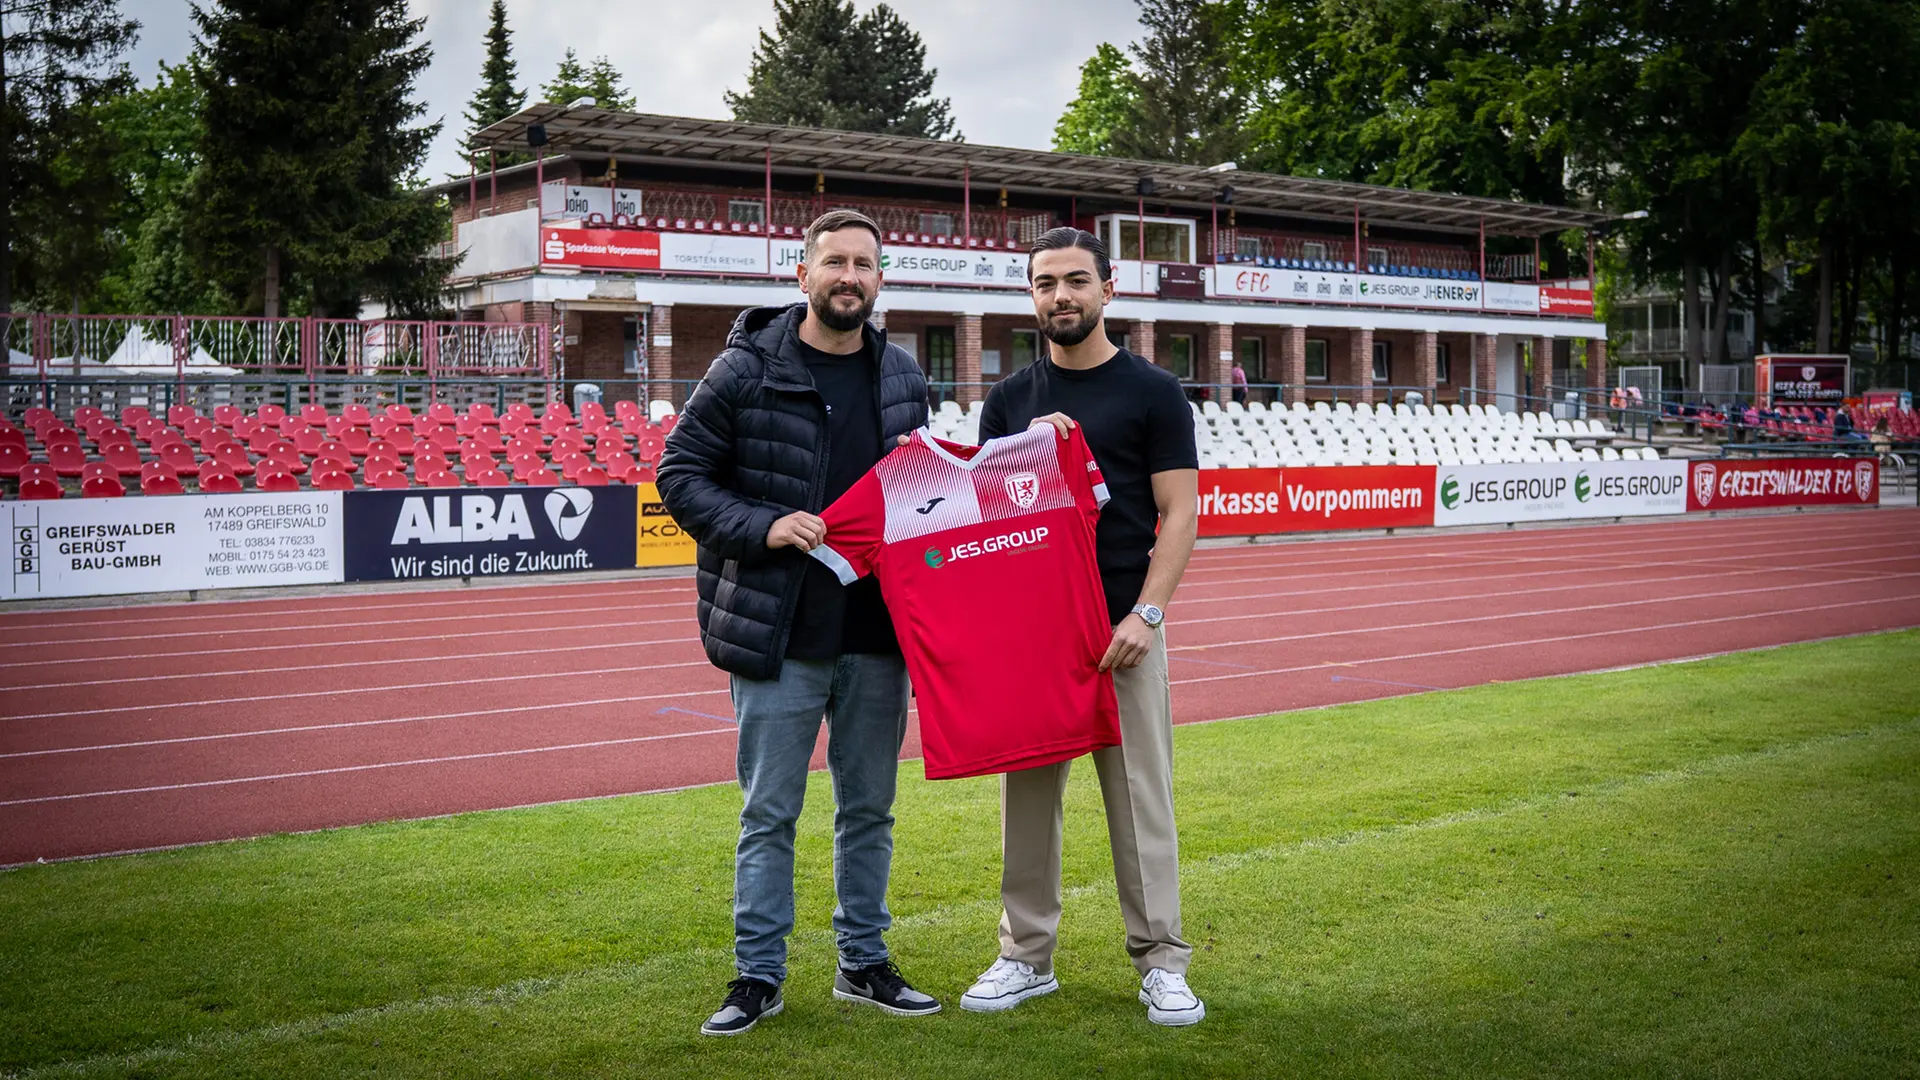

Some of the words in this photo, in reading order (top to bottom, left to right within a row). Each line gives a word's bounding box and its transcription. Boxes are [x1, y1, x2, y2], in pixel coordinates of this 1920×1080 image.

[1464, 477, 1566, 504] JES.GROUP
[1594, 475, 1683, 497] JES.GROUP
[1719, 468, 1832, 498] GREIFSWALDER
[1834, 469, 1852, 495] FC
[1286, 484, 1422, 518] Vorpommern
[204, 507, 224, 518] AM
[227, 504, 311, 518] KOPPELBERG
[316, 504, 329, 515] 10
[390, 494, 535, 545] ALBA
[46, 522, 175, 539] GREIFSWALDER
[208, 520, 243, 532] 17489
[246, 517, 326, 530] GREIFSWALD
[59, 538, 126, 555] GERÜST
[220, 538, 241, 548] TEL:
[245, 537, 275, 548] 03834
[279, 535, 315, 546] 776233
[947, 527, 1049, 562] JES.GROUP
[71, 555, 161, 570] BAU-GMBH
[208, 552, 246, 563] MOBIL:
[249, 550, 274, 561] 0175
[277, 549, 289, 560] 54
[292, 549, 305, 559] 23
[307, 548, 326, 558] 423
[391, 557, 426, 578] Wir
[431, 554, 474, 576] sind
[480, 552, 510, 574] die
[515, 549, 593, 572] Zukunft.
[205, 565, 232, 576] WEB:
[236, 561, 329, 575] WWW.GGB-VG.DE
